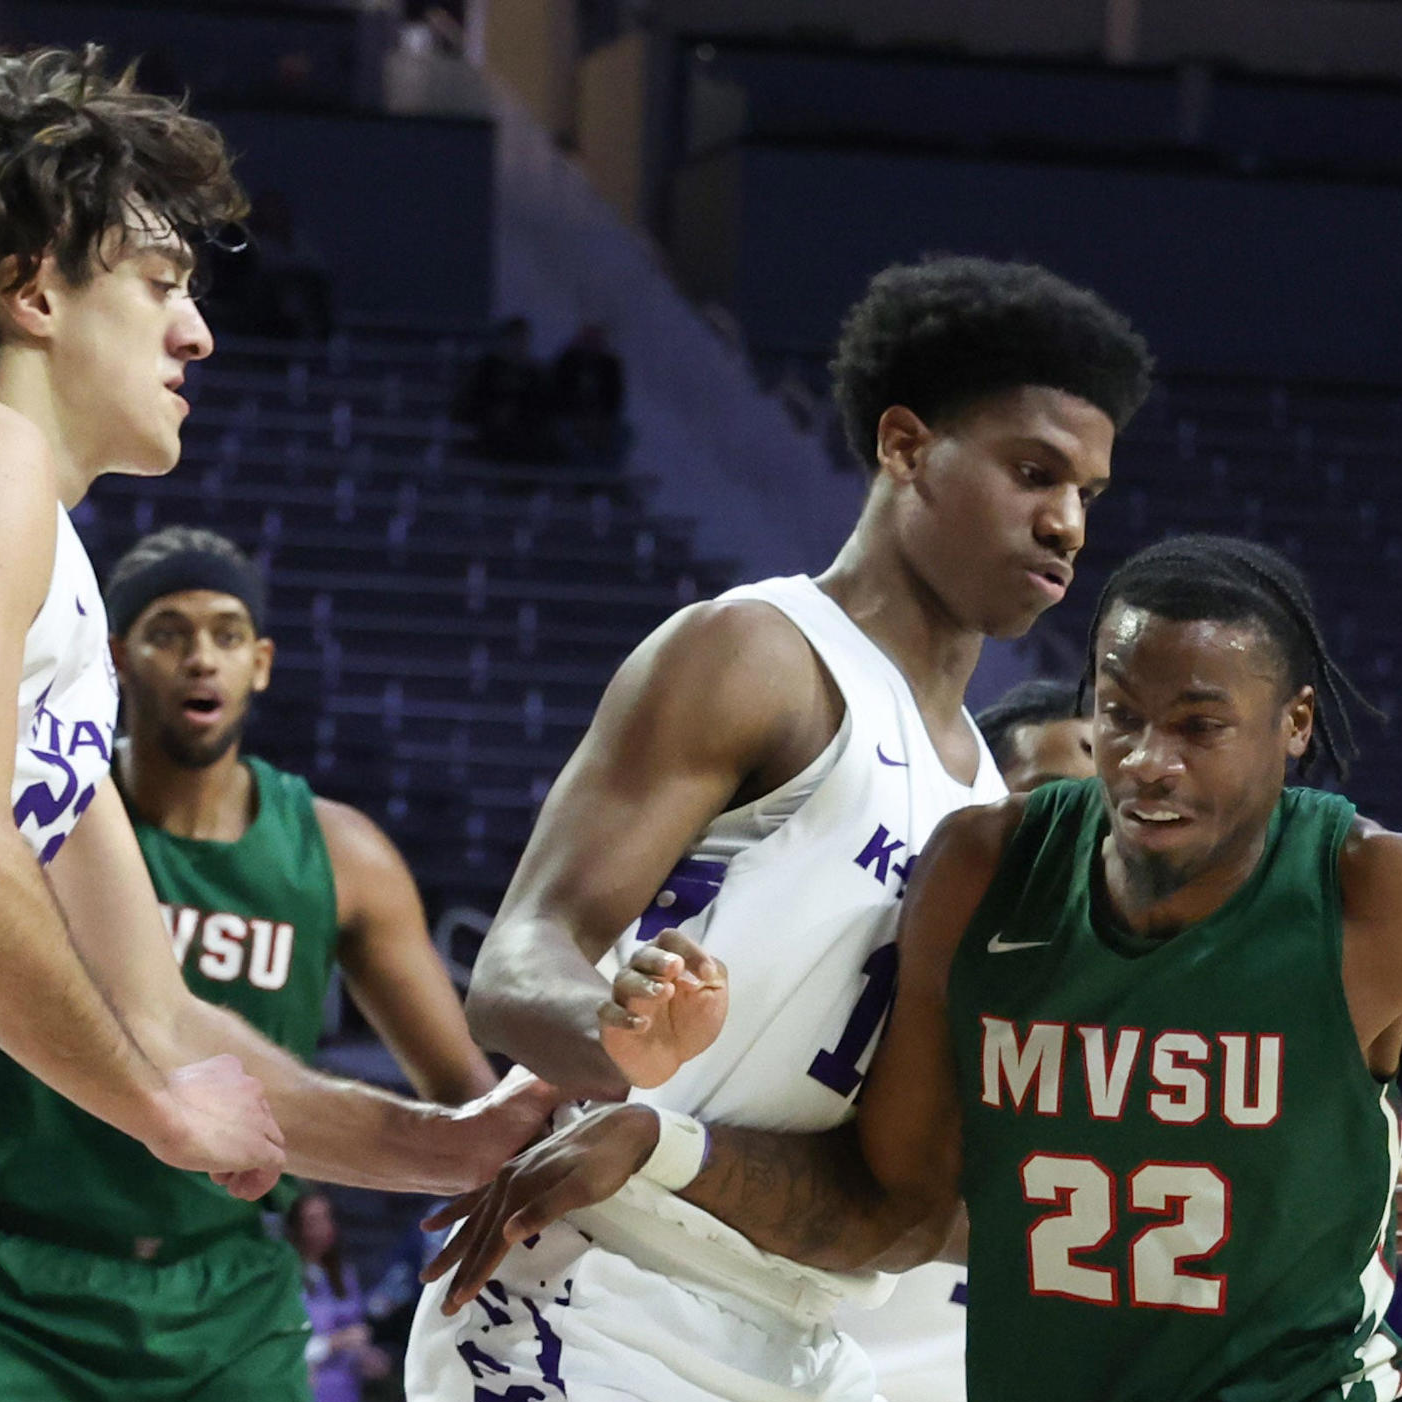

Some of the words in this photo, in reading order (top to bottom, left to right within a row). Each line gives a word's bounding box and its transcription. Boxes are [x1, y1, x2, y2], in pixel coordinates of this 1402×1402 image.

[148, 901, 295, 990] VSU
[978, 1012, 1286, 1129] MVSU
[1018, 1150, 1233, 1317] 22
